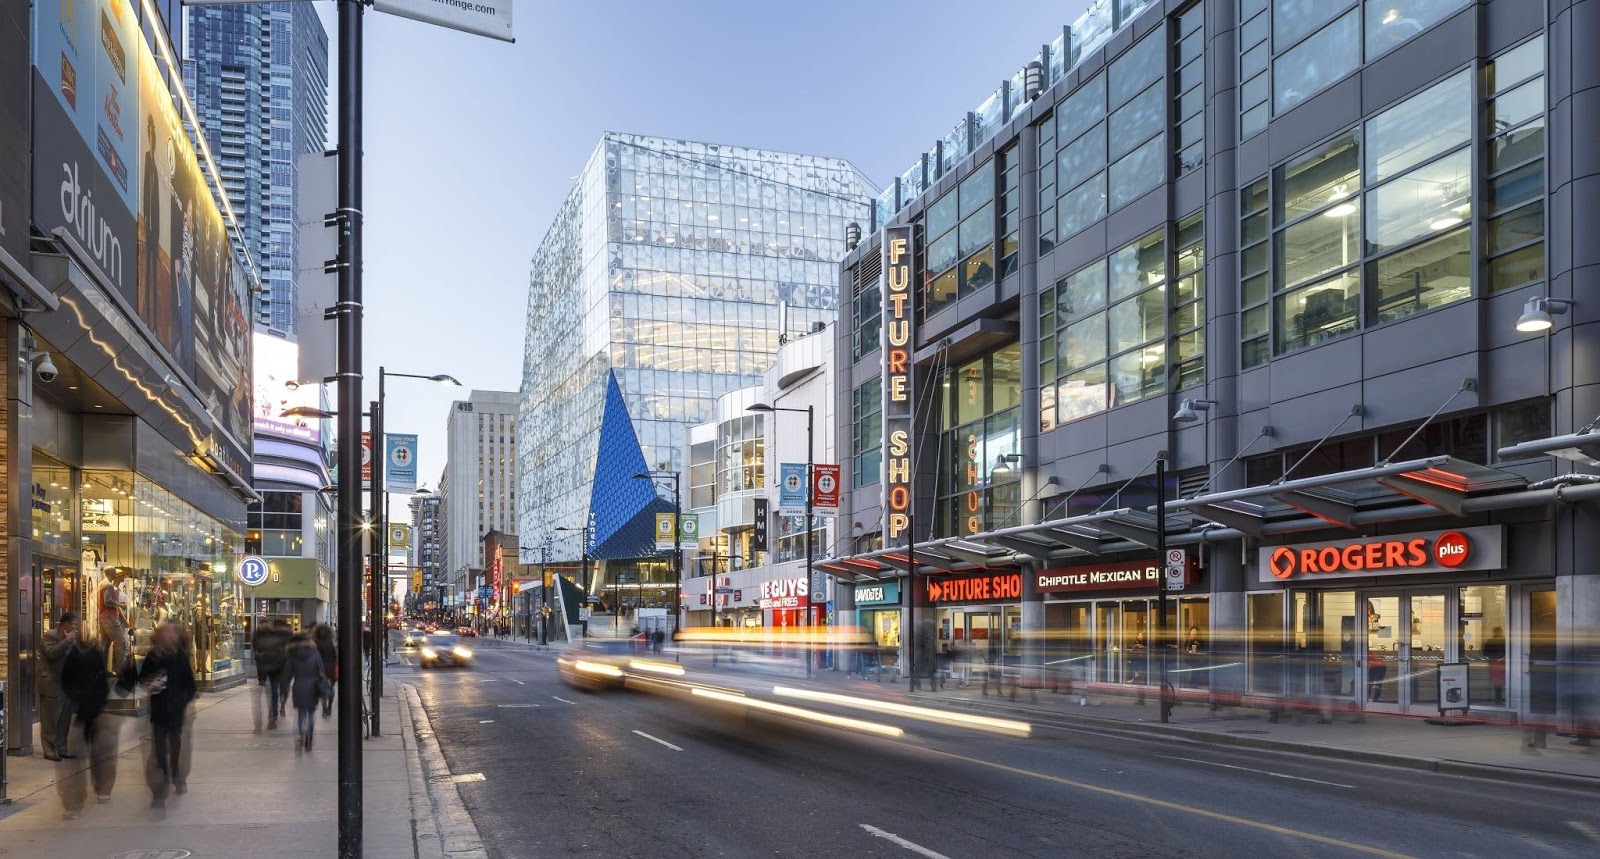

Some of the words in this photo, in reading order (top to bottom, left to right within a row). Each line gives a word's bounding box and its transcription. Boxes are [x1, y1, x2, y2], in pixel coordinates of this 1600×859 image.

[60, 160, 122, 287] atrium
[889, 238, 909, 402] FUTURE
[458, 402, 473, 412] 415
[889, 429, 909, 538] SHOP
[756, 508, 765, 543] HMV
[1300, 538, 1428, 574] ROGERS
[1439, 543, 1465, 558] plus
[771, 577, 808, 598] GUYS
[942, 577, 990, 602] FUTURE
[992, 573, 1023, 599] SHO
[1038, 575, 1088, 587] CHIPOTLE
[1090, 569, 1142, 584] MEXICAN
